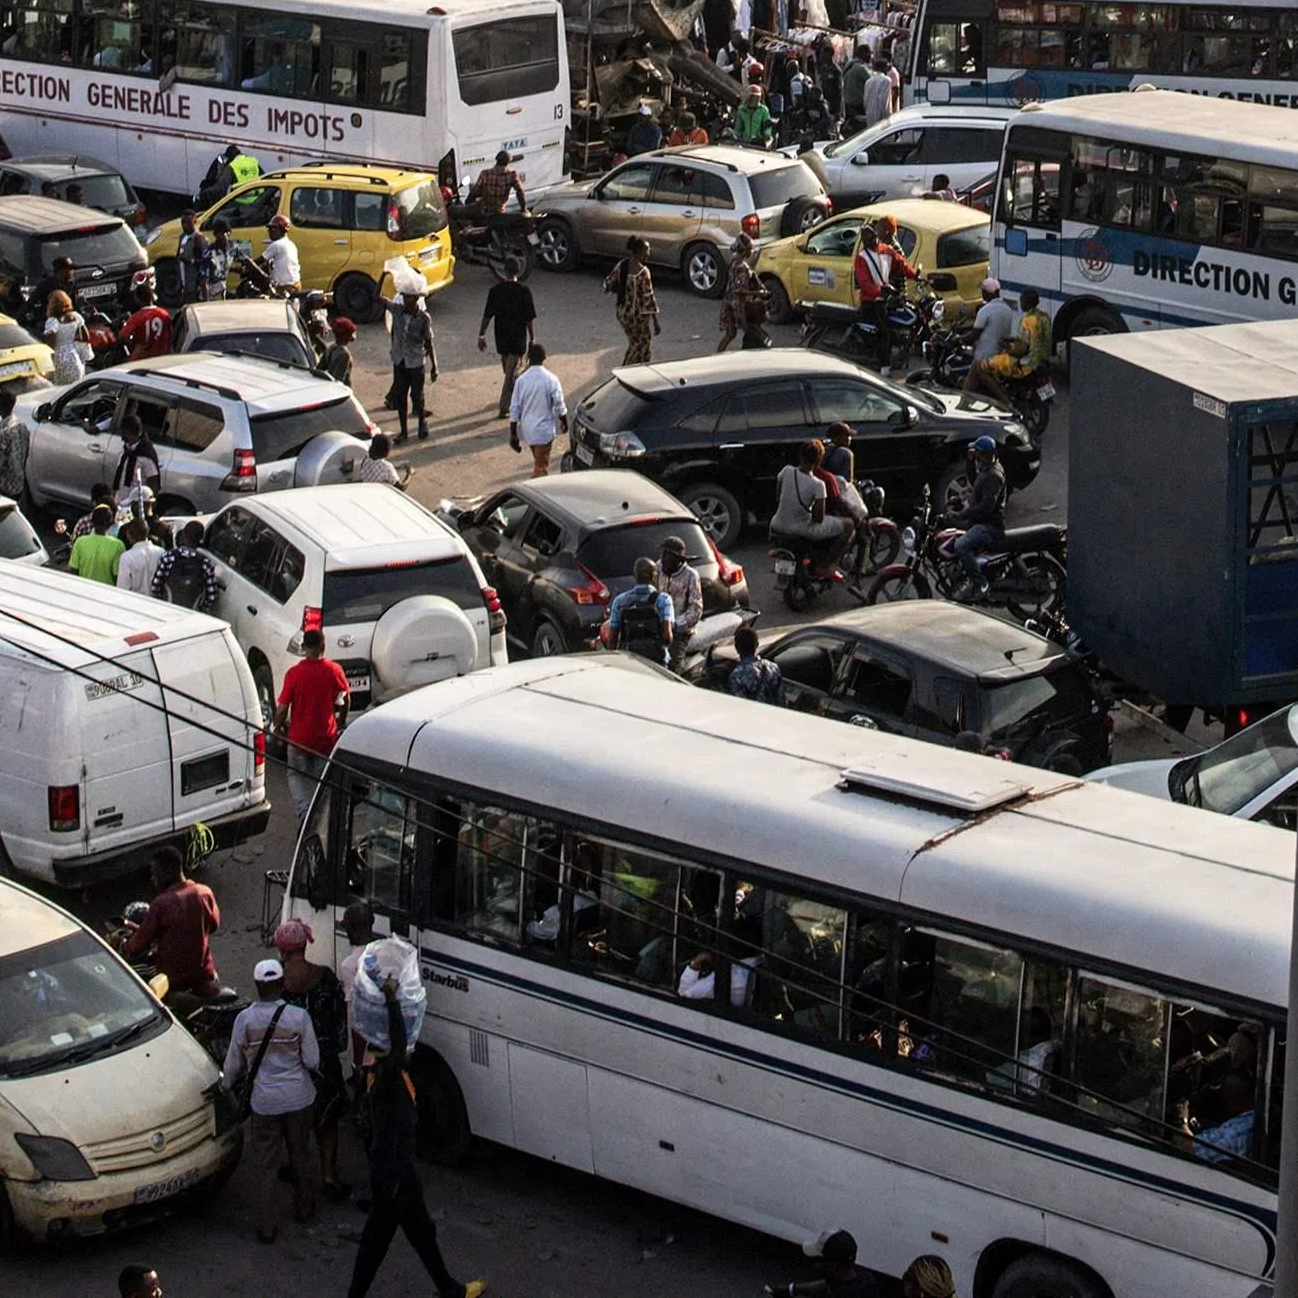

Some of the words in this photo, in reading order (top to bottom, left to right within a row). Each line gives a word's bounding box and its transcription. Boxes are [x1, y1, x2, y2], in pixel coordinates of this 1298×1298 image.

[87, 82, 191, 121] GENERALE
[208, 98, 250, 128] DES
[267, 106, 345, 142] IMPOTS
[553, 103, 564, 120] 13
[504, 138, 525, 151] TATA
[1133, 250, 1270, 300] DIRECTION
[145, 317, 163, 340] 19
[422, 967, 470, 993] Starbus
